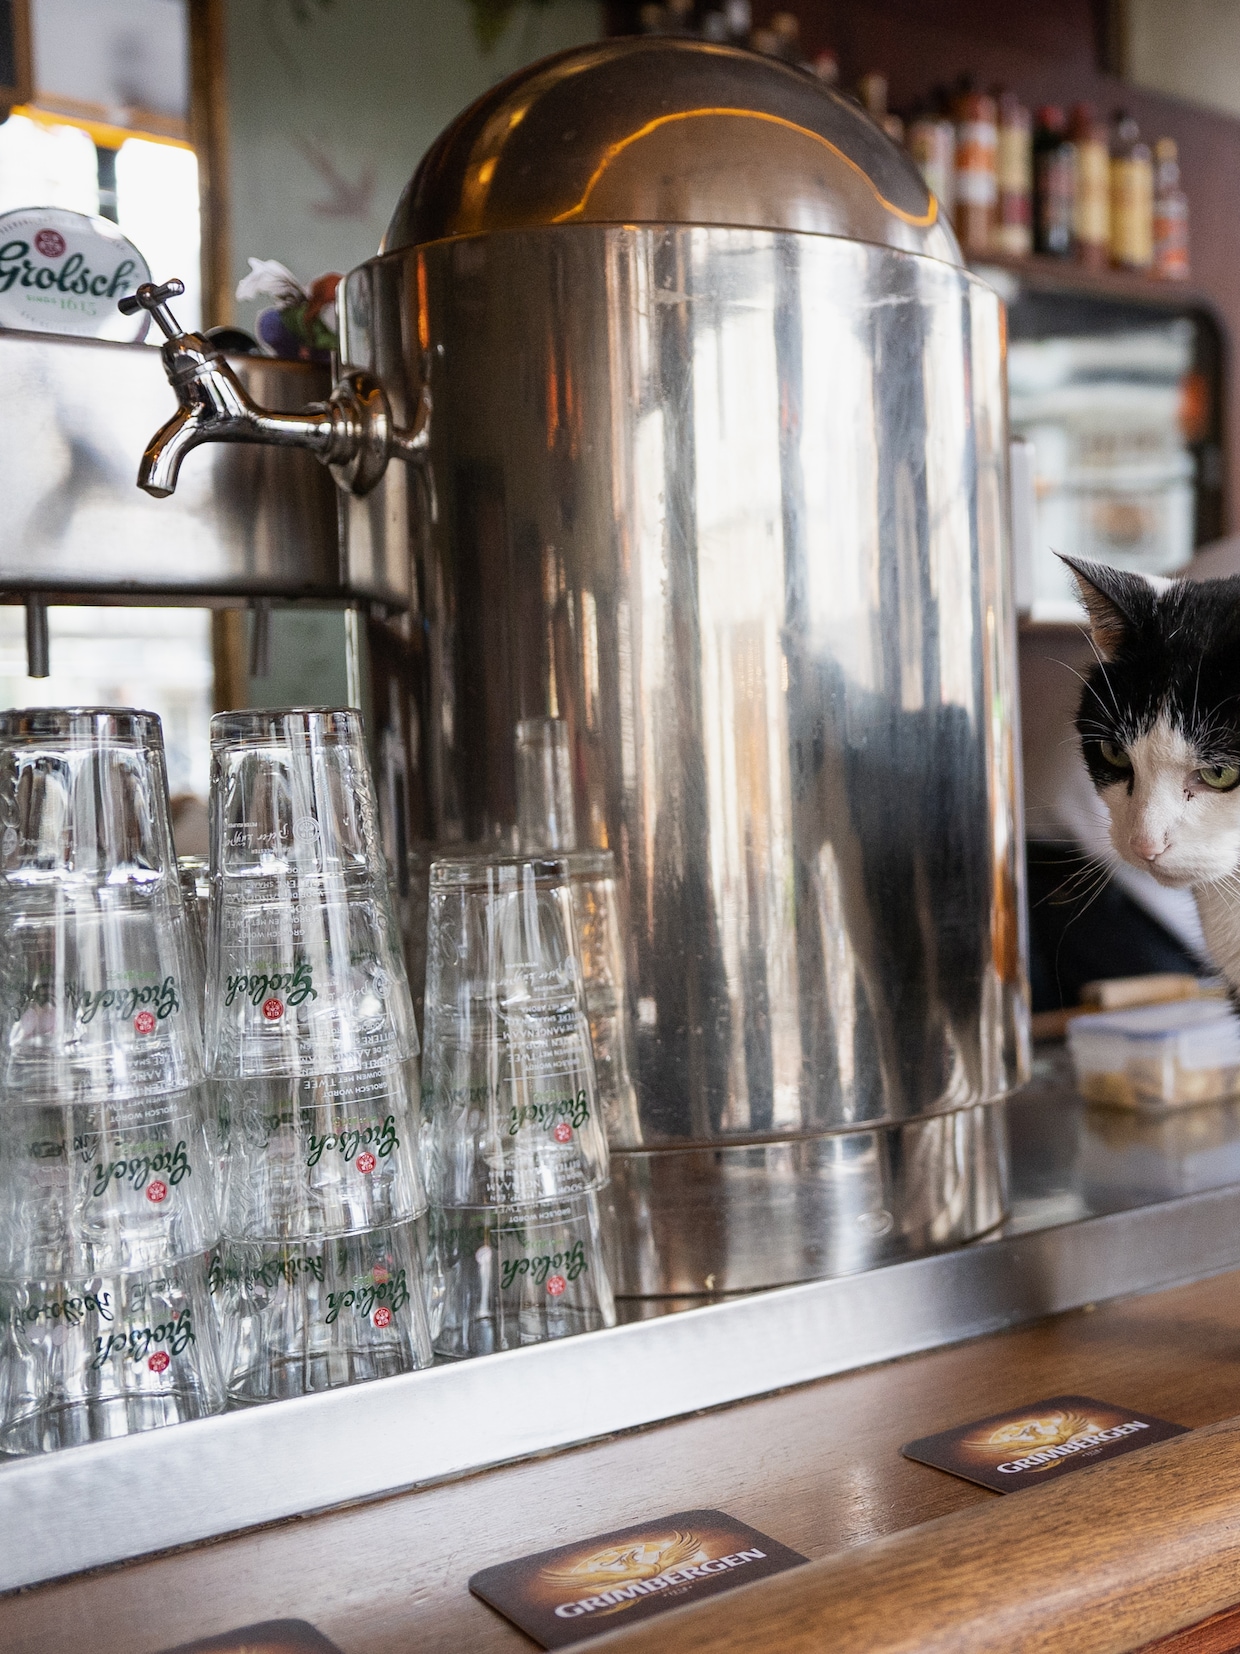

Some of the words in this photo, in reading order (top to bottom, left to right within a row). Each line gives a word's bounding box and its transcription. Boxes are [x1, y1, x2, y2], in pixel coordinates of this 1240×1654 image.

[0, 240, 136, 298] Grolsch
[80, 976, 180, 1024] Grolsch
[225, 965, 318, 1006] Grolsch
[303, 1077, 337, 1090] TWEE
[322, 1087, 354, 1098] WORDT
[338, 1074, 355, 1084] MET
[354, 1081, 388, 1094] GROLSCH
[509, 1089, 590, 1136] Grolsch
[307, 1115, 400, 1167] Grolsch
[93, 1141, 192, 1197] Grolsch
[499, 1241, 588, 1290] Grolsch
[324, 1269, 410, 1324] Grolsch
[91, 1309, 196, 1370] Grolsch
[995, 1420, 1151, 1474] GRIMBERGEN
[554, 1547, 768, 1618] GRIMBERGEN
